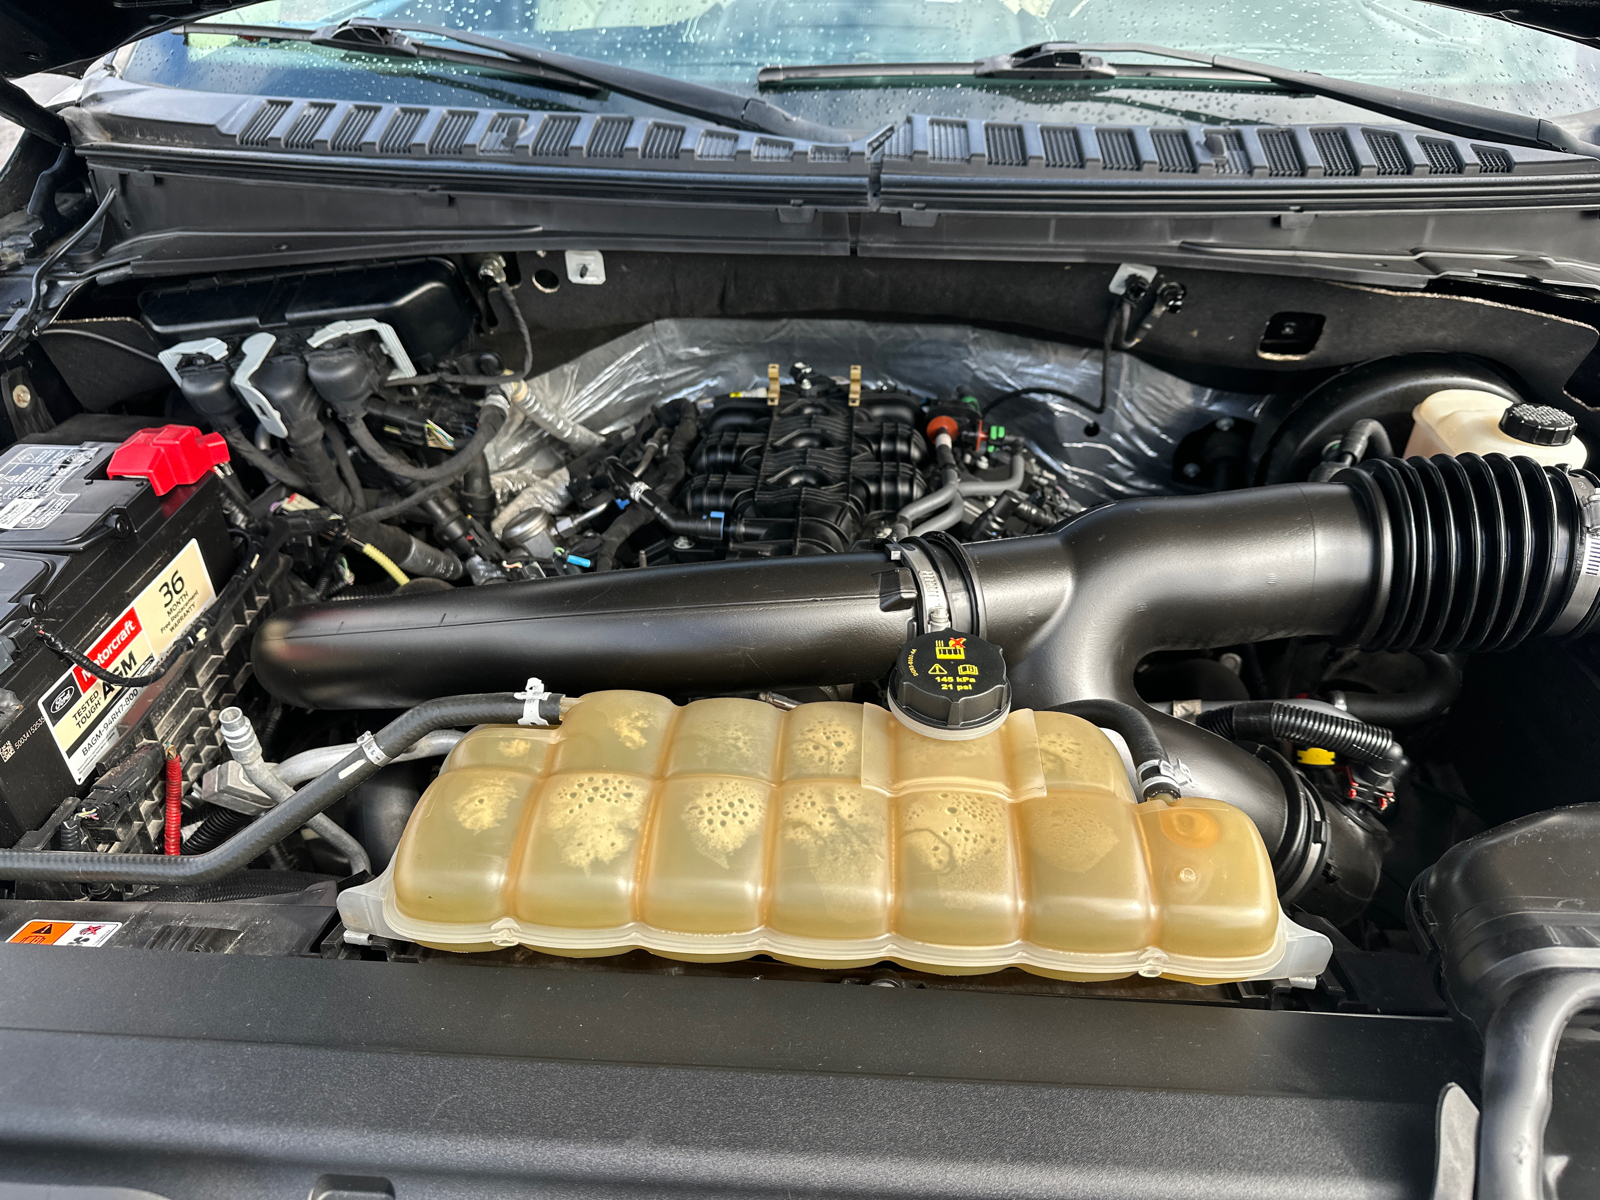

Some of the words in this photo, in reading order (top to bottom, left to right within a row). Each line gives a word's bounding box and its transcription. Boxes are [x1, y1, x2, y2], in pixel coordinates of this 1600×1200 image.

[158, 570, 185, 608] 36
[167, 591, 189, 617] MONTH
[160, 621, 171, 634] Free
[170, 589, 199, 622] Replacement
[169, 602, 195, 633] WARRANTY
[81, 620, 136, 682] Mtorcraft
[72, 690, 99, 721] TESTED
[82, 688, 139, 756] BAGM-94RH7-800
